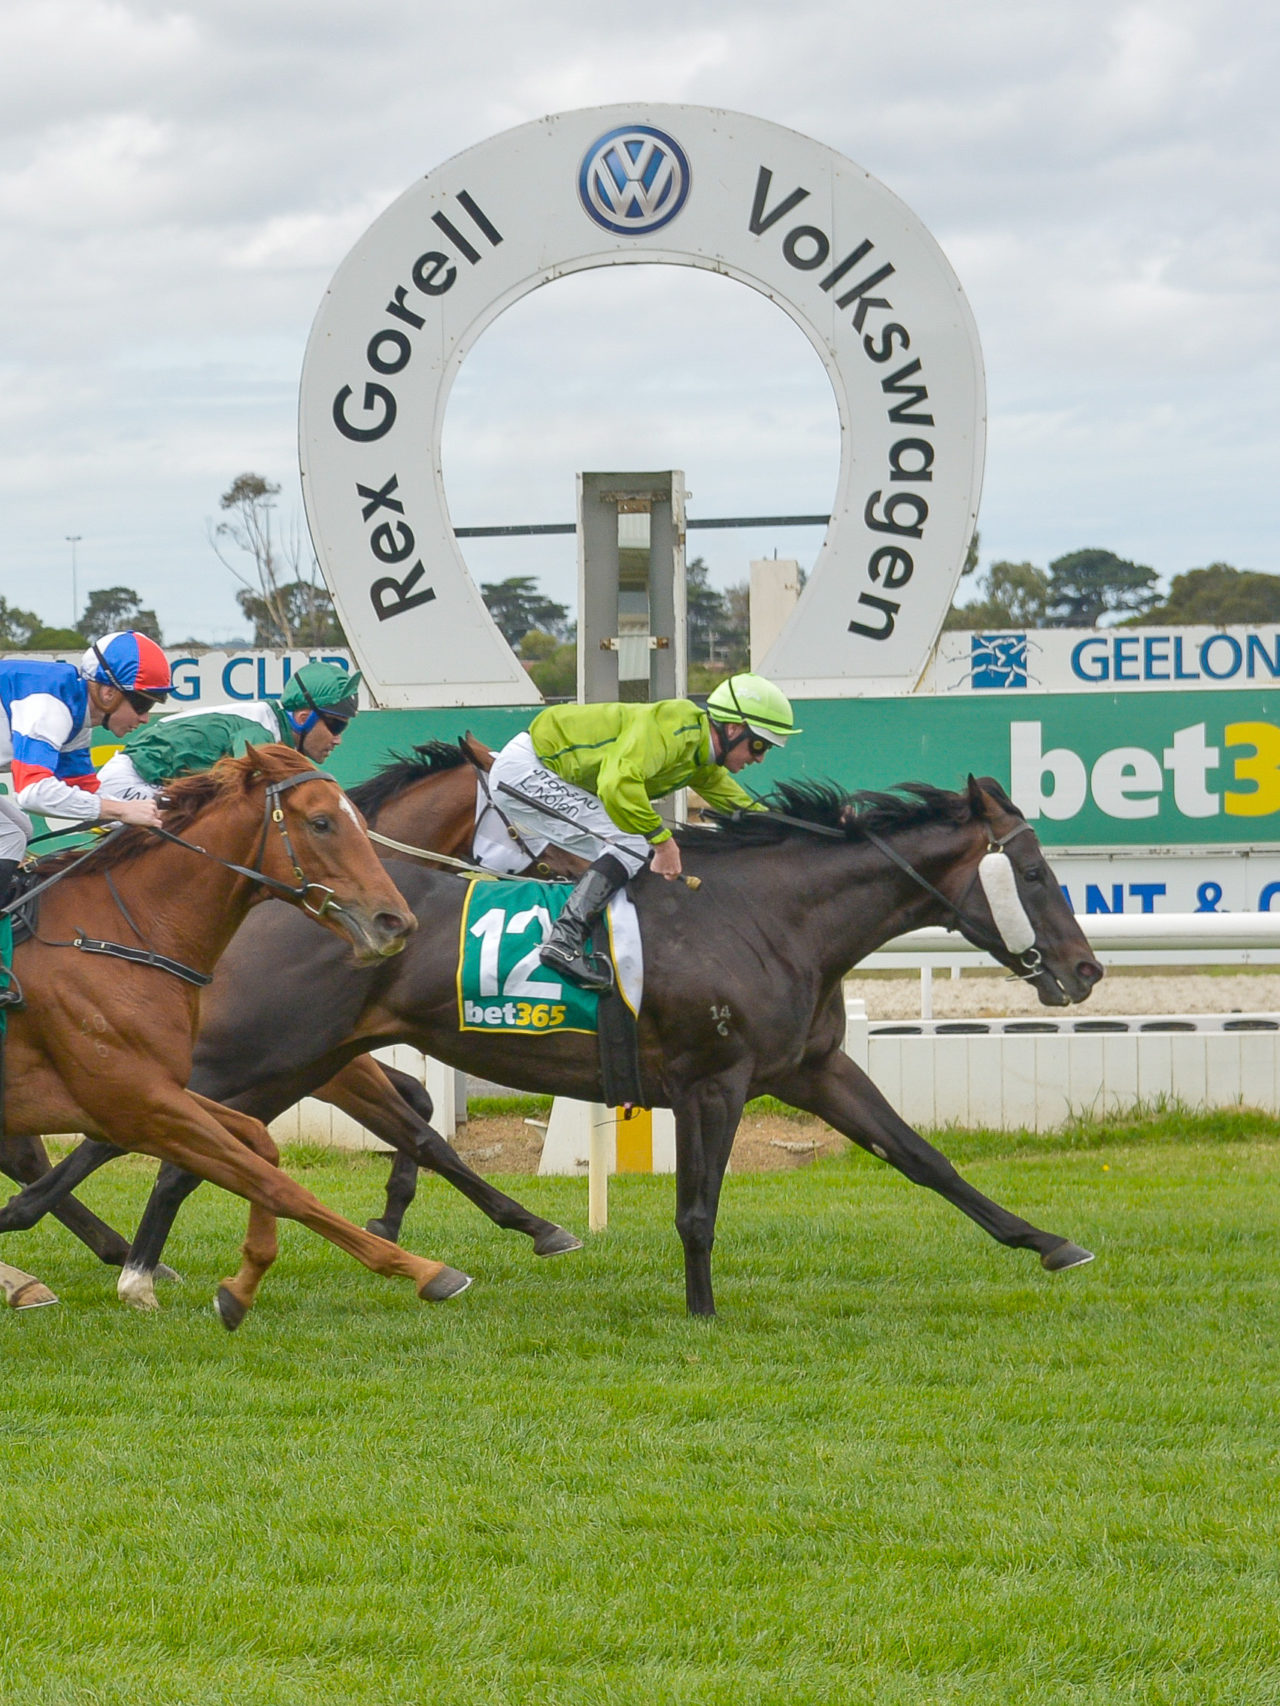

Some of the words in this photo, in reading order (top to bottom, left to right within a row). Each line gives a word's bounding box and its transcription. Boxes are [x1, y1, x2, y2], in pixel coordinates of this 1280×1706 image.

[333, 190, 503, 442] Gorell
[749, 165, 935, 642] Volkswagen
[355, 474, 436, 622] Rex
[464, 1000, 566, 1027] bet365
[470, 904, 562, 1000] 12
